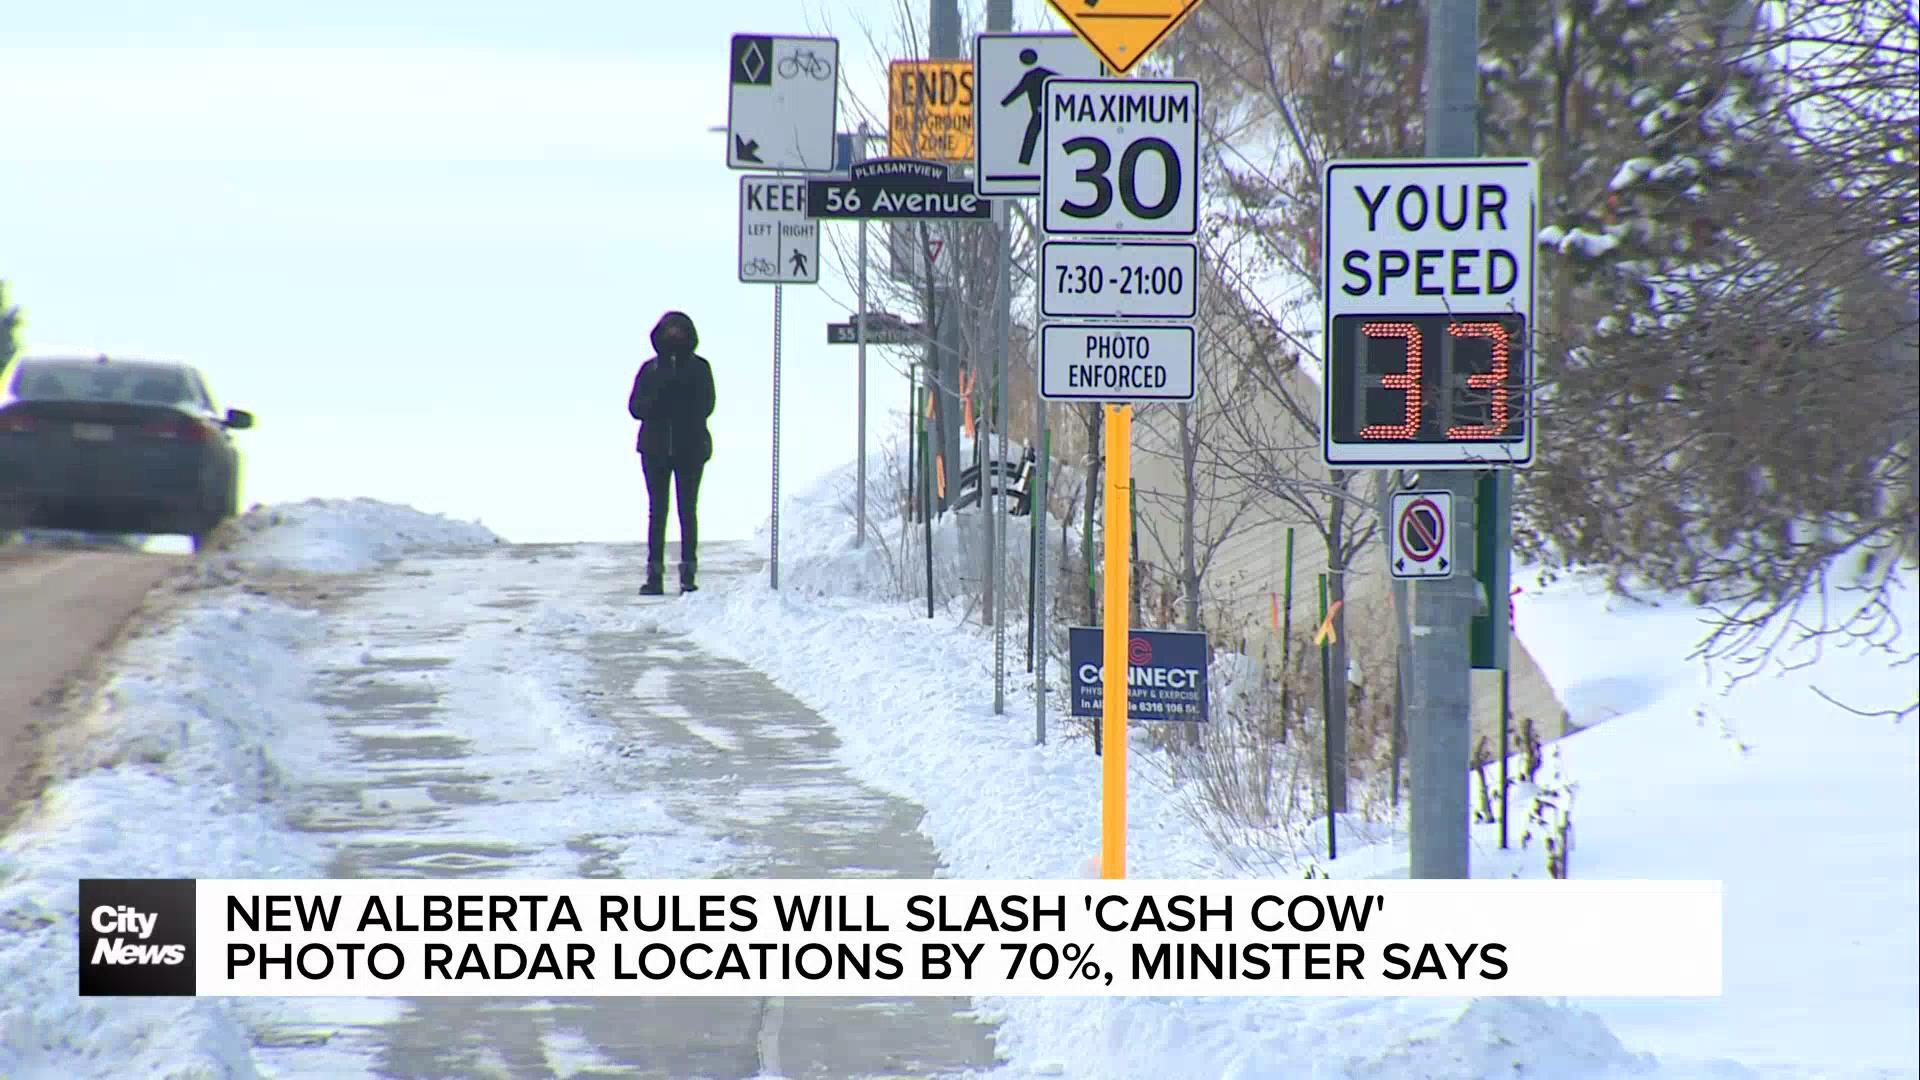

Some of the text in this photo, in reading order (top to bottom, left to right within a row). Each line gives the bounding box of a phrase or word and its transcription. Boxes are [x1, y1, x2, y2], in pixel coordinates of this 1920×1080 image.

[902, 71, 974, 105] ENDS
[1055, 94, 1189, 123] MAXIMUM
[855, 162, 944, 179] PLEASANTVIEW
[1060, 136, 1182, 220] 30
[825, 188, 977, 213] 56 Avenue
[1354, 184, 1508, 231] YOUR
[748, 223, 772, 236] LEFT
[783, 224, 814, 237] RIGHT
[1055, 265, 1104, 294] 7:30
[1342, 249, 1520, 296] SPEED
[1086, 335, 1150, 359] PHOTO
[1068, 364, 1167, 388] ENFORCED
[1359, 322, 1509, 440] 33
[1081, 698, 1091, 709] In
